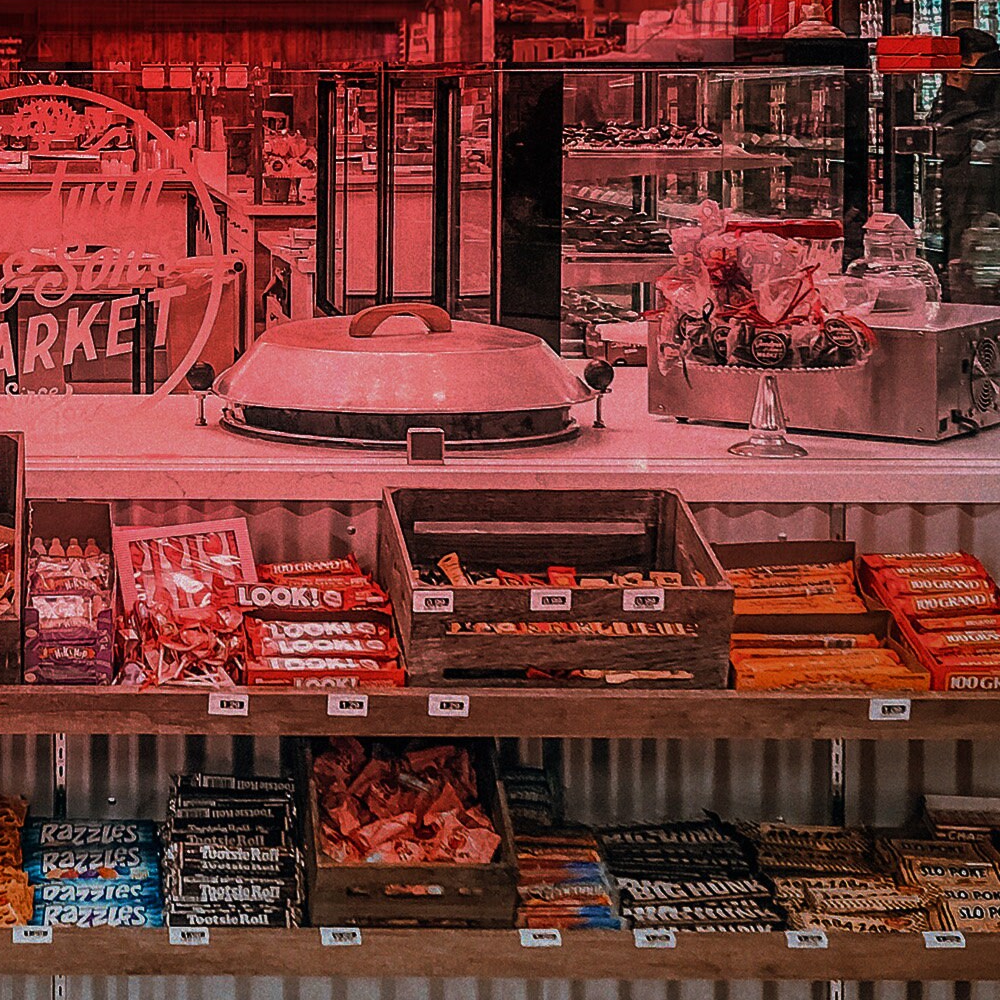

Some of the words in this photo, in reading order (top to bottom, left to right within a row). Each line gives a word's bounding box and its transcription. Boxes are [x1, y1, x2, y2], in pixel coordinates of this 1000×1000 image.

[237, 585, 320, 607] LOOK!
[278, 639, 363, 655] LOOK!
[950, 676, 979, 690] 100
[40, 823, 138, 846] Razzles
[42, 846, 141, 873] Razzles
[919, 865, 946, 877] SLO
[949, 867, 987, 878] POKE
[943, 890, 969, 900] SLO
[44, 904, 147, 928] Razzles
[186, 914, 239, 926] Tootsie
[239, 914, 270, 926] Roll
[958, 906, 985, 919] SLO
